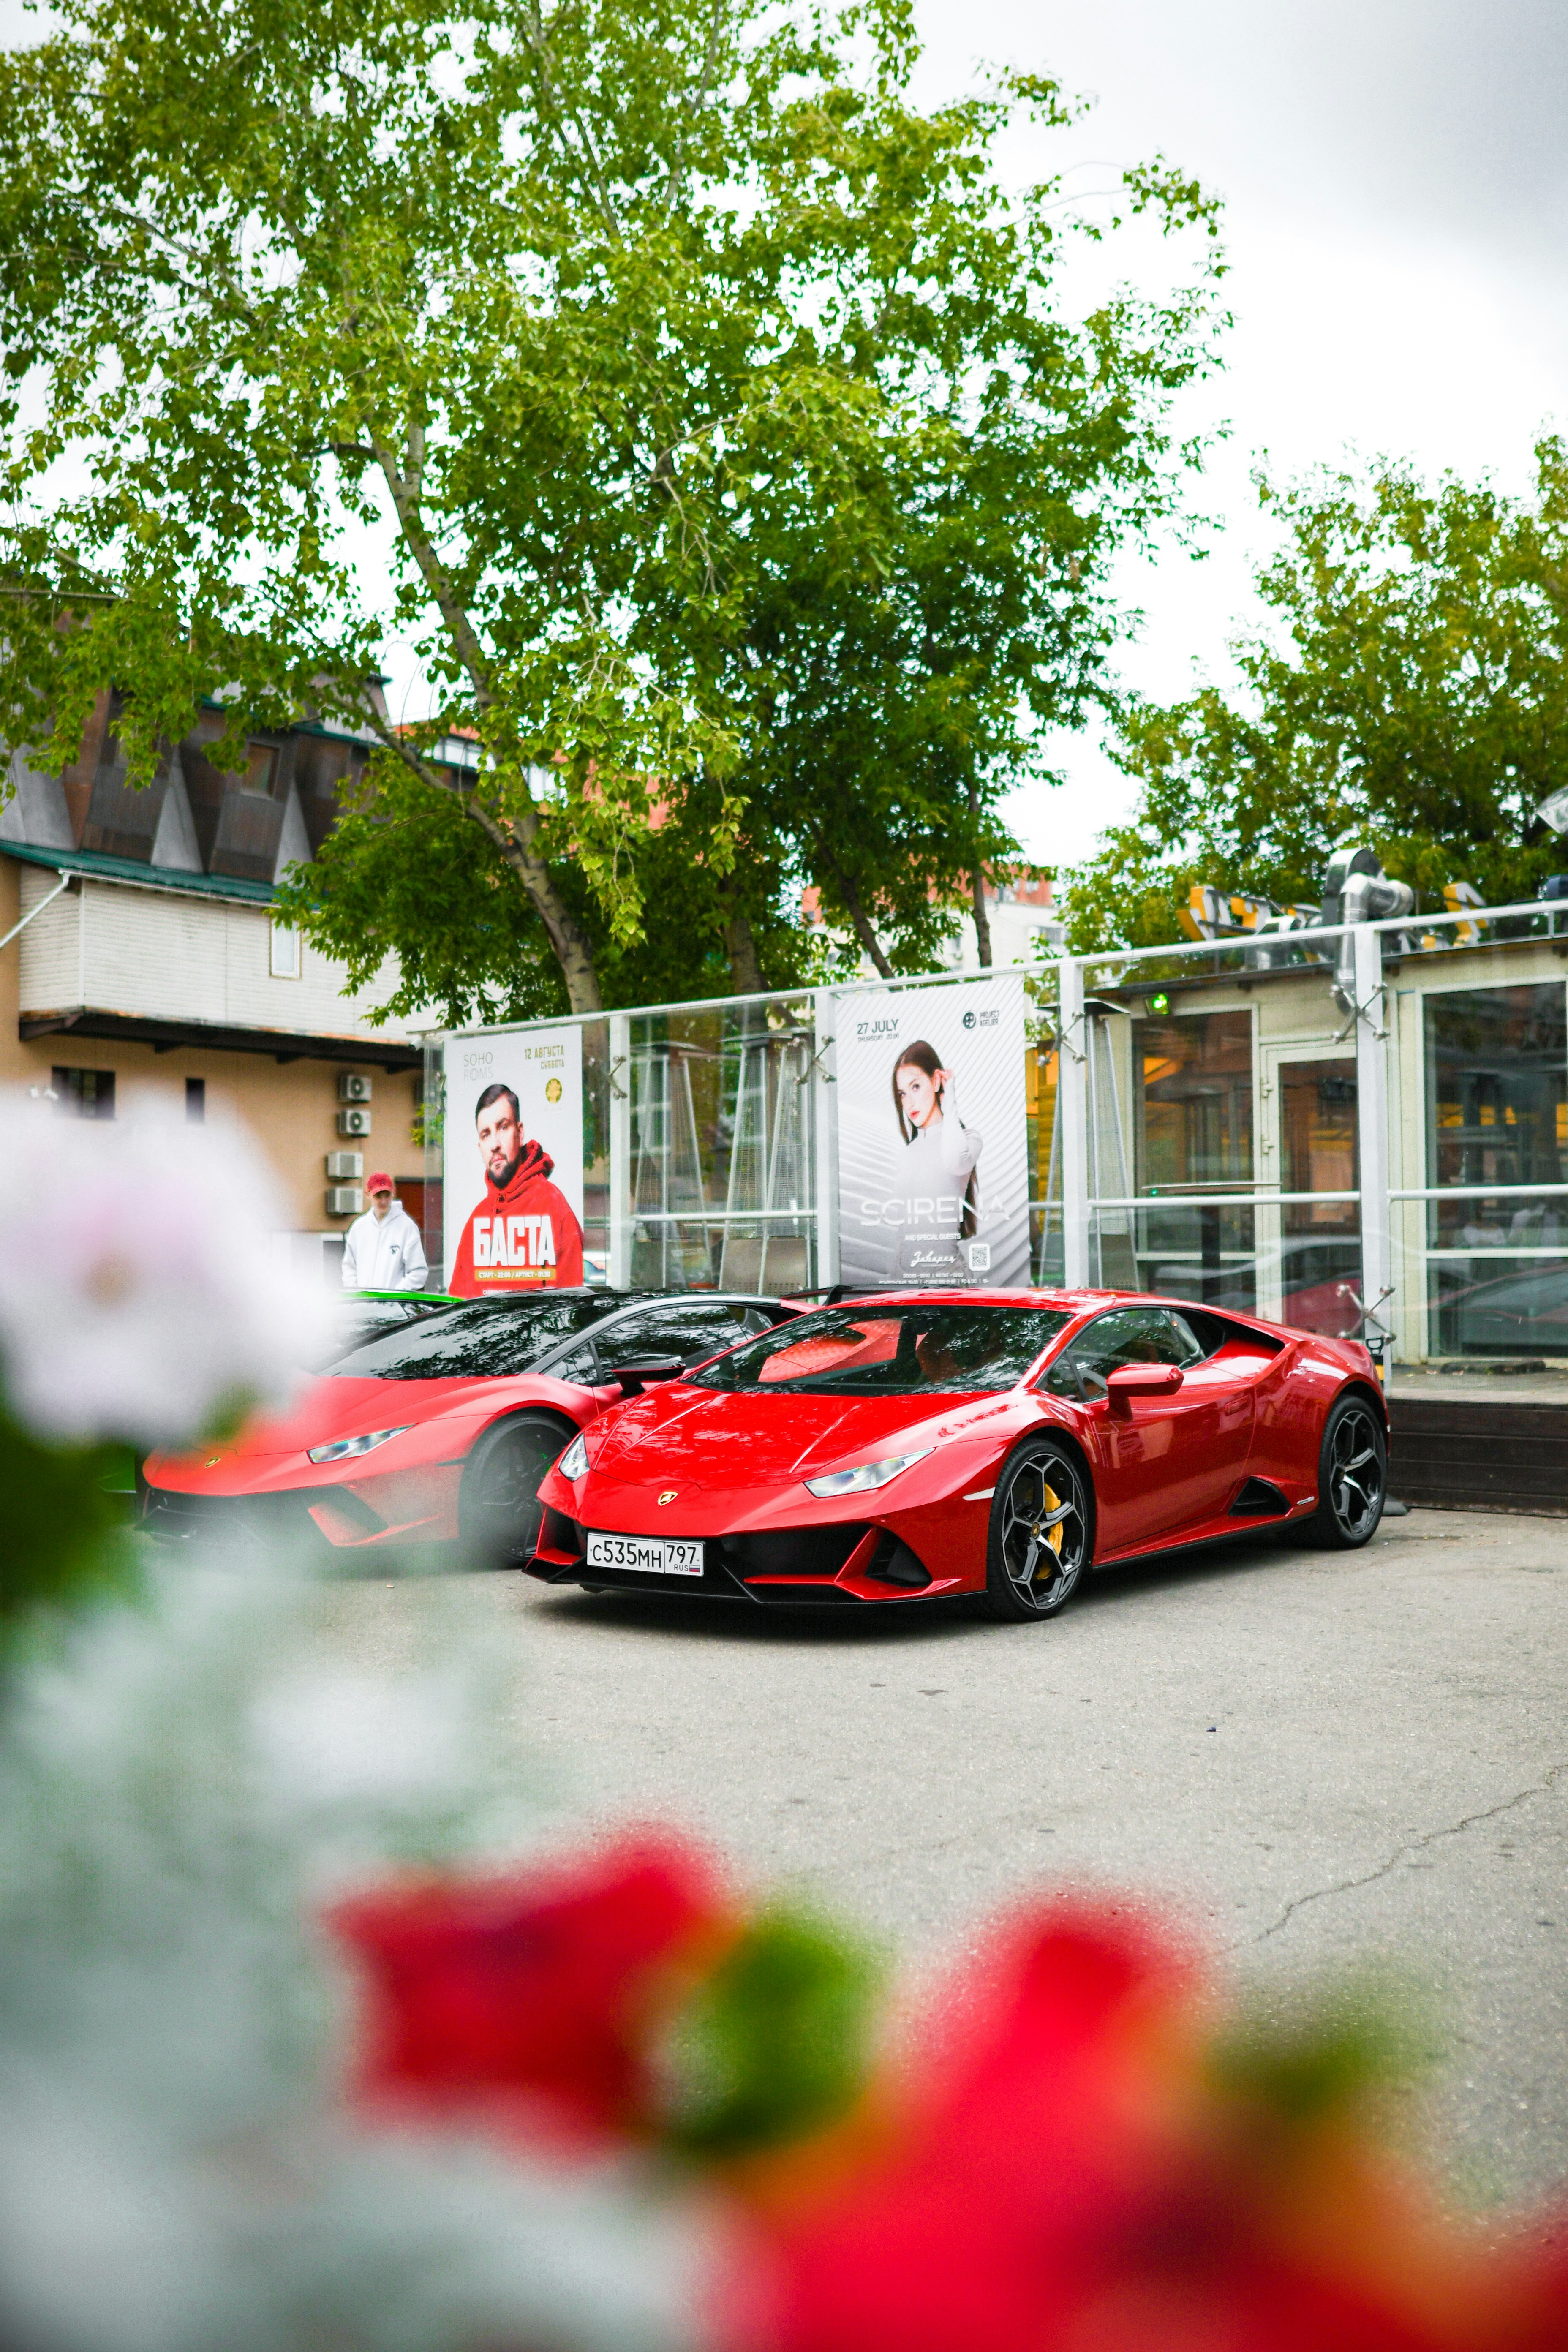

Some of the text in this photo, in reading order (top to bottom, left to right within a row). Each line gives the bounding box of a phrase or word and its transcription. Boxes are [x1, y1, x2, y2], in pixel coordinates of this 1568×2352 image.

[980, 1010, 999, 1019] PROJECT
[857, 1019, 898, 1034] 27 JULY
[980, 1018, 999, 1027] ATELIER
[857, 1034, 883, 1043] THURSDAY
[464, 1052, 493, 1067] SOHO
[524, 1045, 564, 1060] 12 АВГУСТА
[540, 1059, 564, 1070] СУББОТА
[861, 1195, 1010, 1227] SCIRENA
[474, 1215, 556, 1266] БАСТА
[667, 1545, 696, 1564] 797
